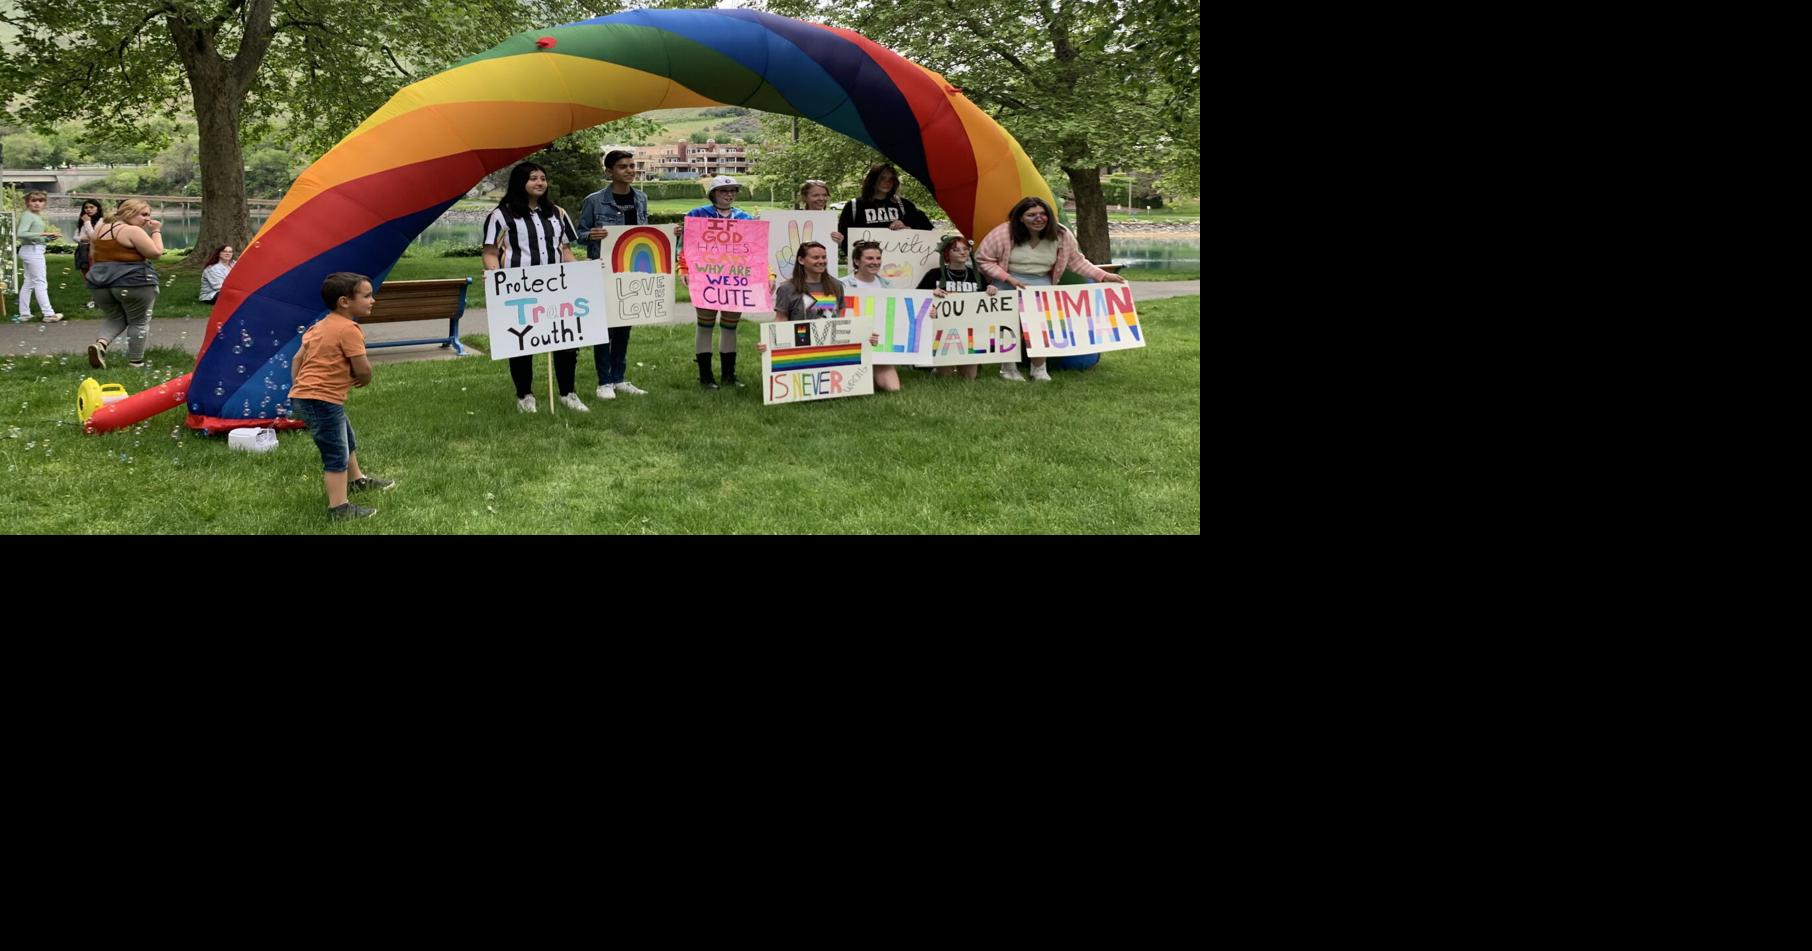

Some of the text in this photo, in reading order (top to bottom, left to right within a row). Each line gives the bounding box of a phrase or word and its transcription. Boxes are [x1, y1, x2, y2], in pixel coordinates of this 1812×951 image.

[707, 218, 737, 231] IF
[864, 207, 899, 222] DAD
[697, 242, 750, 254] HATES
[702, 230, 743, 244] GOD
[695, 262, 751, 276] WHY ARE
[494, 265, 567, 296] Protect
[616, 276, 665, 300] LOVE
[706, 274, 748, 287] WE SO
[703, 286, 756, 307] CUTE
[932, 296, 1013, 318] YOU ARE
[504, 297, 590, 326] Trans
[619, 299, 667, 321] LOVE
[1018, 286, 1141, 349] HUMAN
[507, 316, 584, 351] Youth!
[768, 319, 852, 348] LVE
[769, 370, 843, 401] IS NEVER
